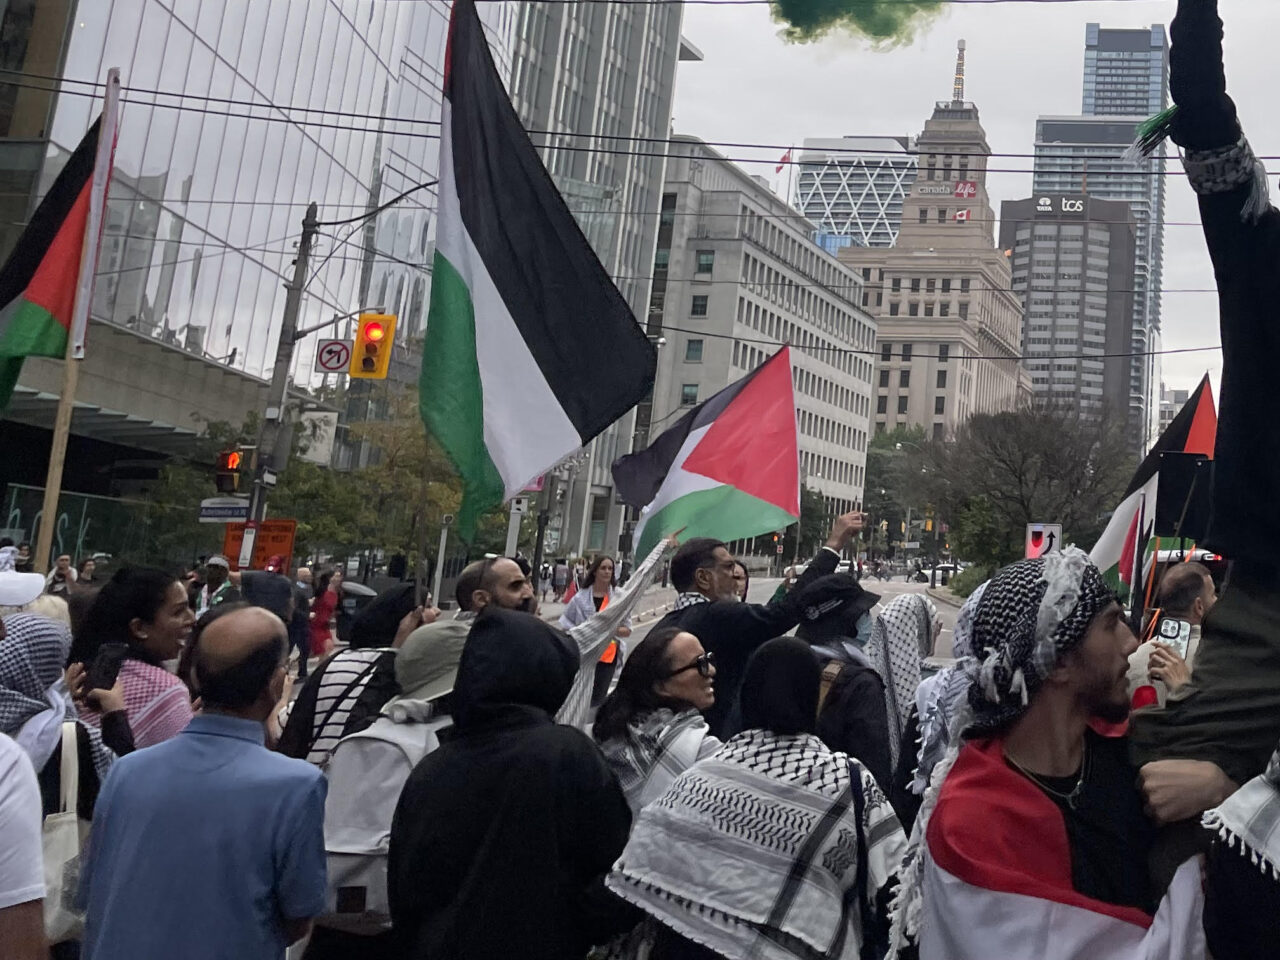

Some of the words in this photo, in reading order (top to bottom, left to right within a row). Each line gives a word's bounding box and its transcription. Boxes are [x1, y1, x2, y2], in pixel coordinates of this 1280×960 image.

[919, 185, 951, 194] canada
[955, 183, 976, 198] life
[1062, 197, 1083, 211] tcs
